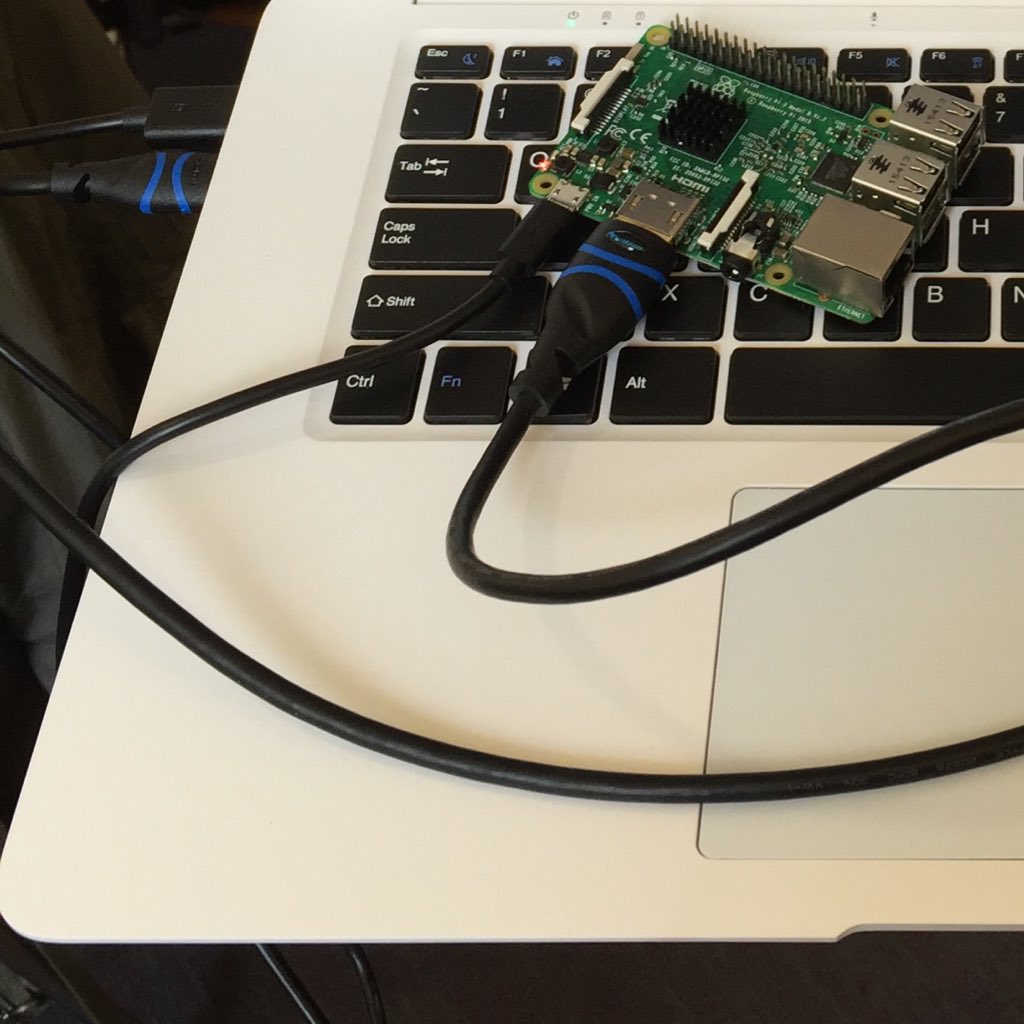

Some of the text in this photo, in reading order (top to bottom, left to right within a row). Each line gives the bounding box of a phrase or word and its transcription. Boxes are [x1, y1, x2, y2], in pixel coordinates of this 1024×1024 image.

[426, 49, 449, 58] Esc
[512, 50, 527, 58] F1
[596, 49, 612, 58] F2
[848, 51, 864, 60] F5
[932, 52, 947, 60] F6
[996, 112, 1006, 123] 7
[400, 161, 422, 171] Tab
[383, 221, 416, 233] Caps
[972, 218, 990, 235] H
[381, 233, 411, 244] Lock
[661, 283, 680, 302] X
[749, 284, 769, 303] C
[926, 285, 944, 303] B
[386, 295, 416, 307] Shift
[346, 374, 375, 388] Ctrl
[440, 375, 462, 388] Fn
[625, 376, 647, 389] Alt
